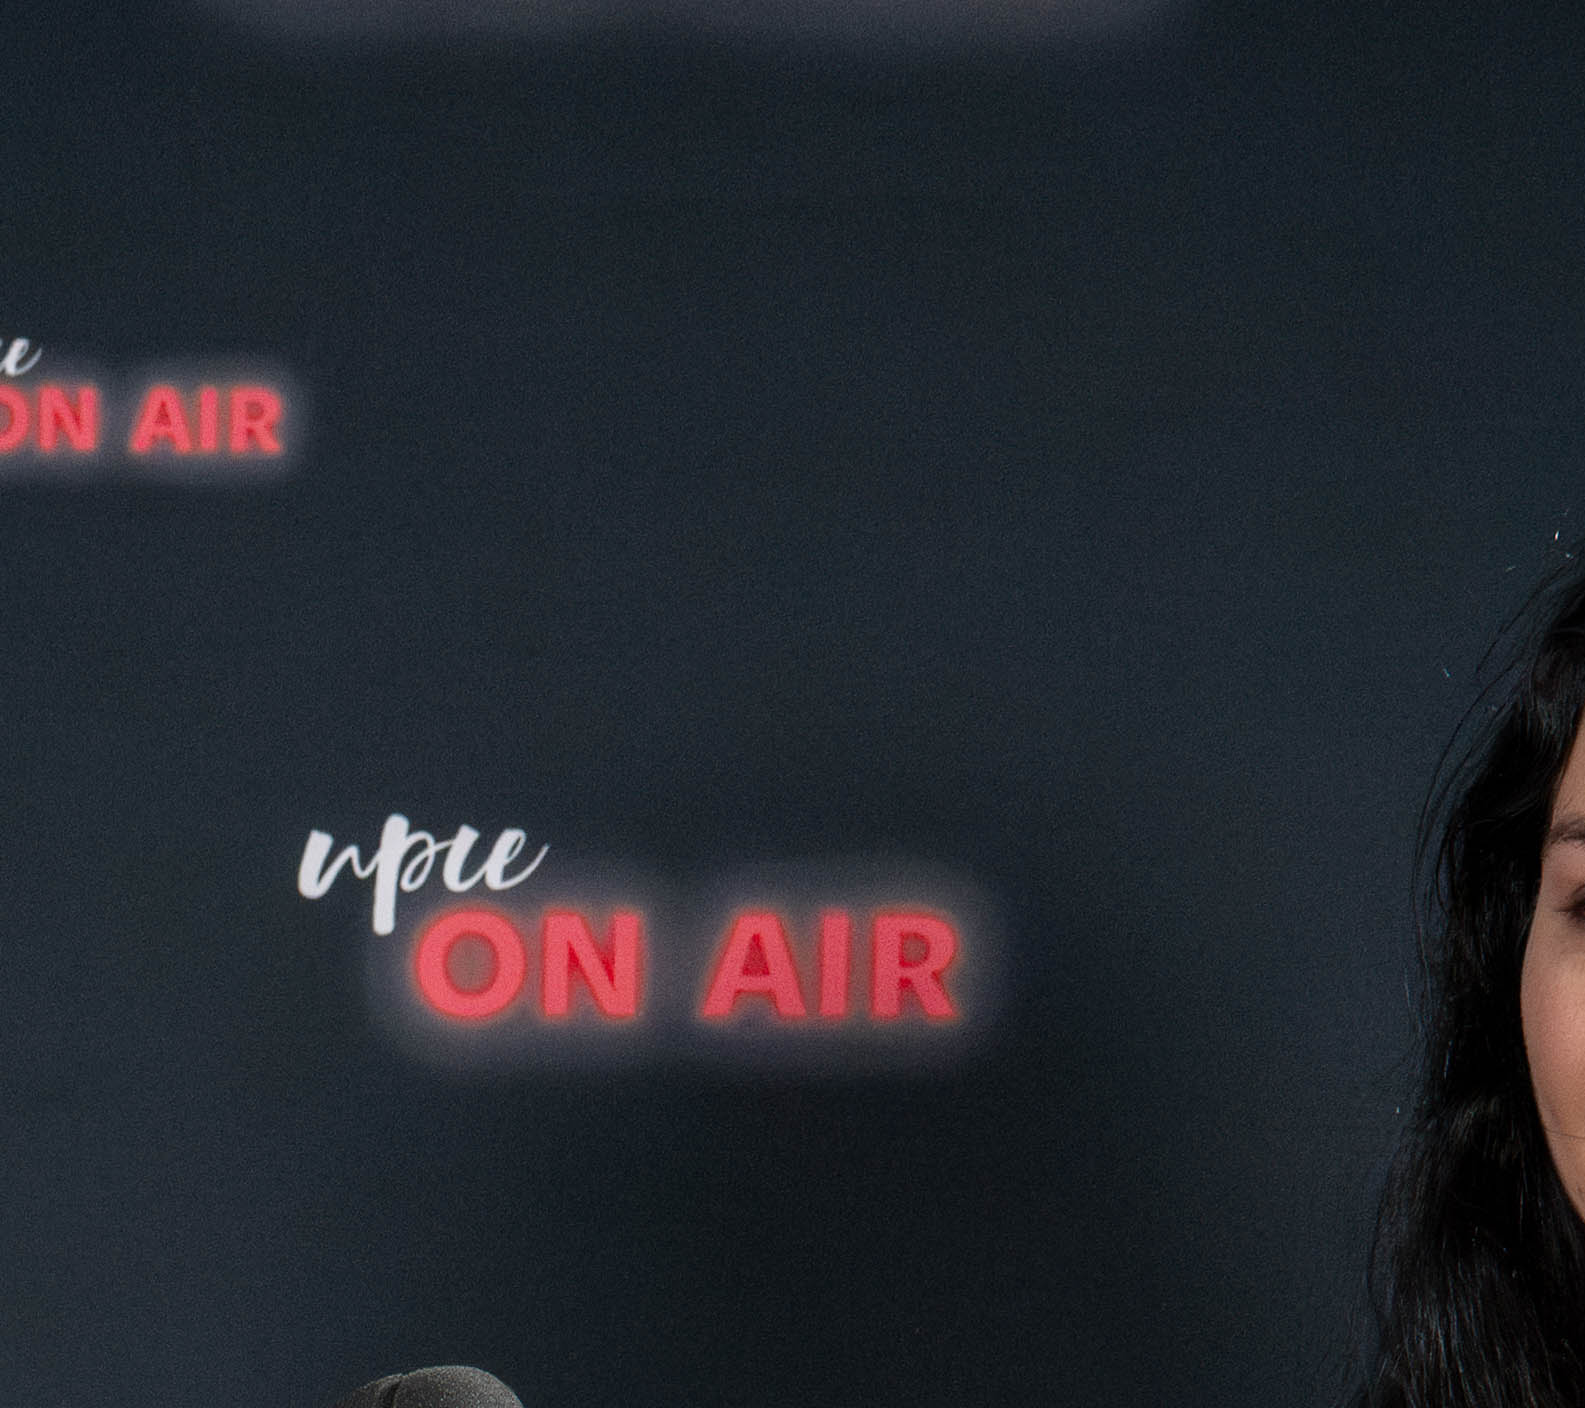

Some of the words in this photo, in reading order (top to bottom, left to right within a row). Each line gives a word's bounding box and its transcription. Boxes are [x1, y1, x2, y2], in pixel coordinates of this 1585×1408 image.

[132, 387, 281, 452] AIR
[414, 908, 643, 1020] ON
[703, 912, 957, 1019] AIR
